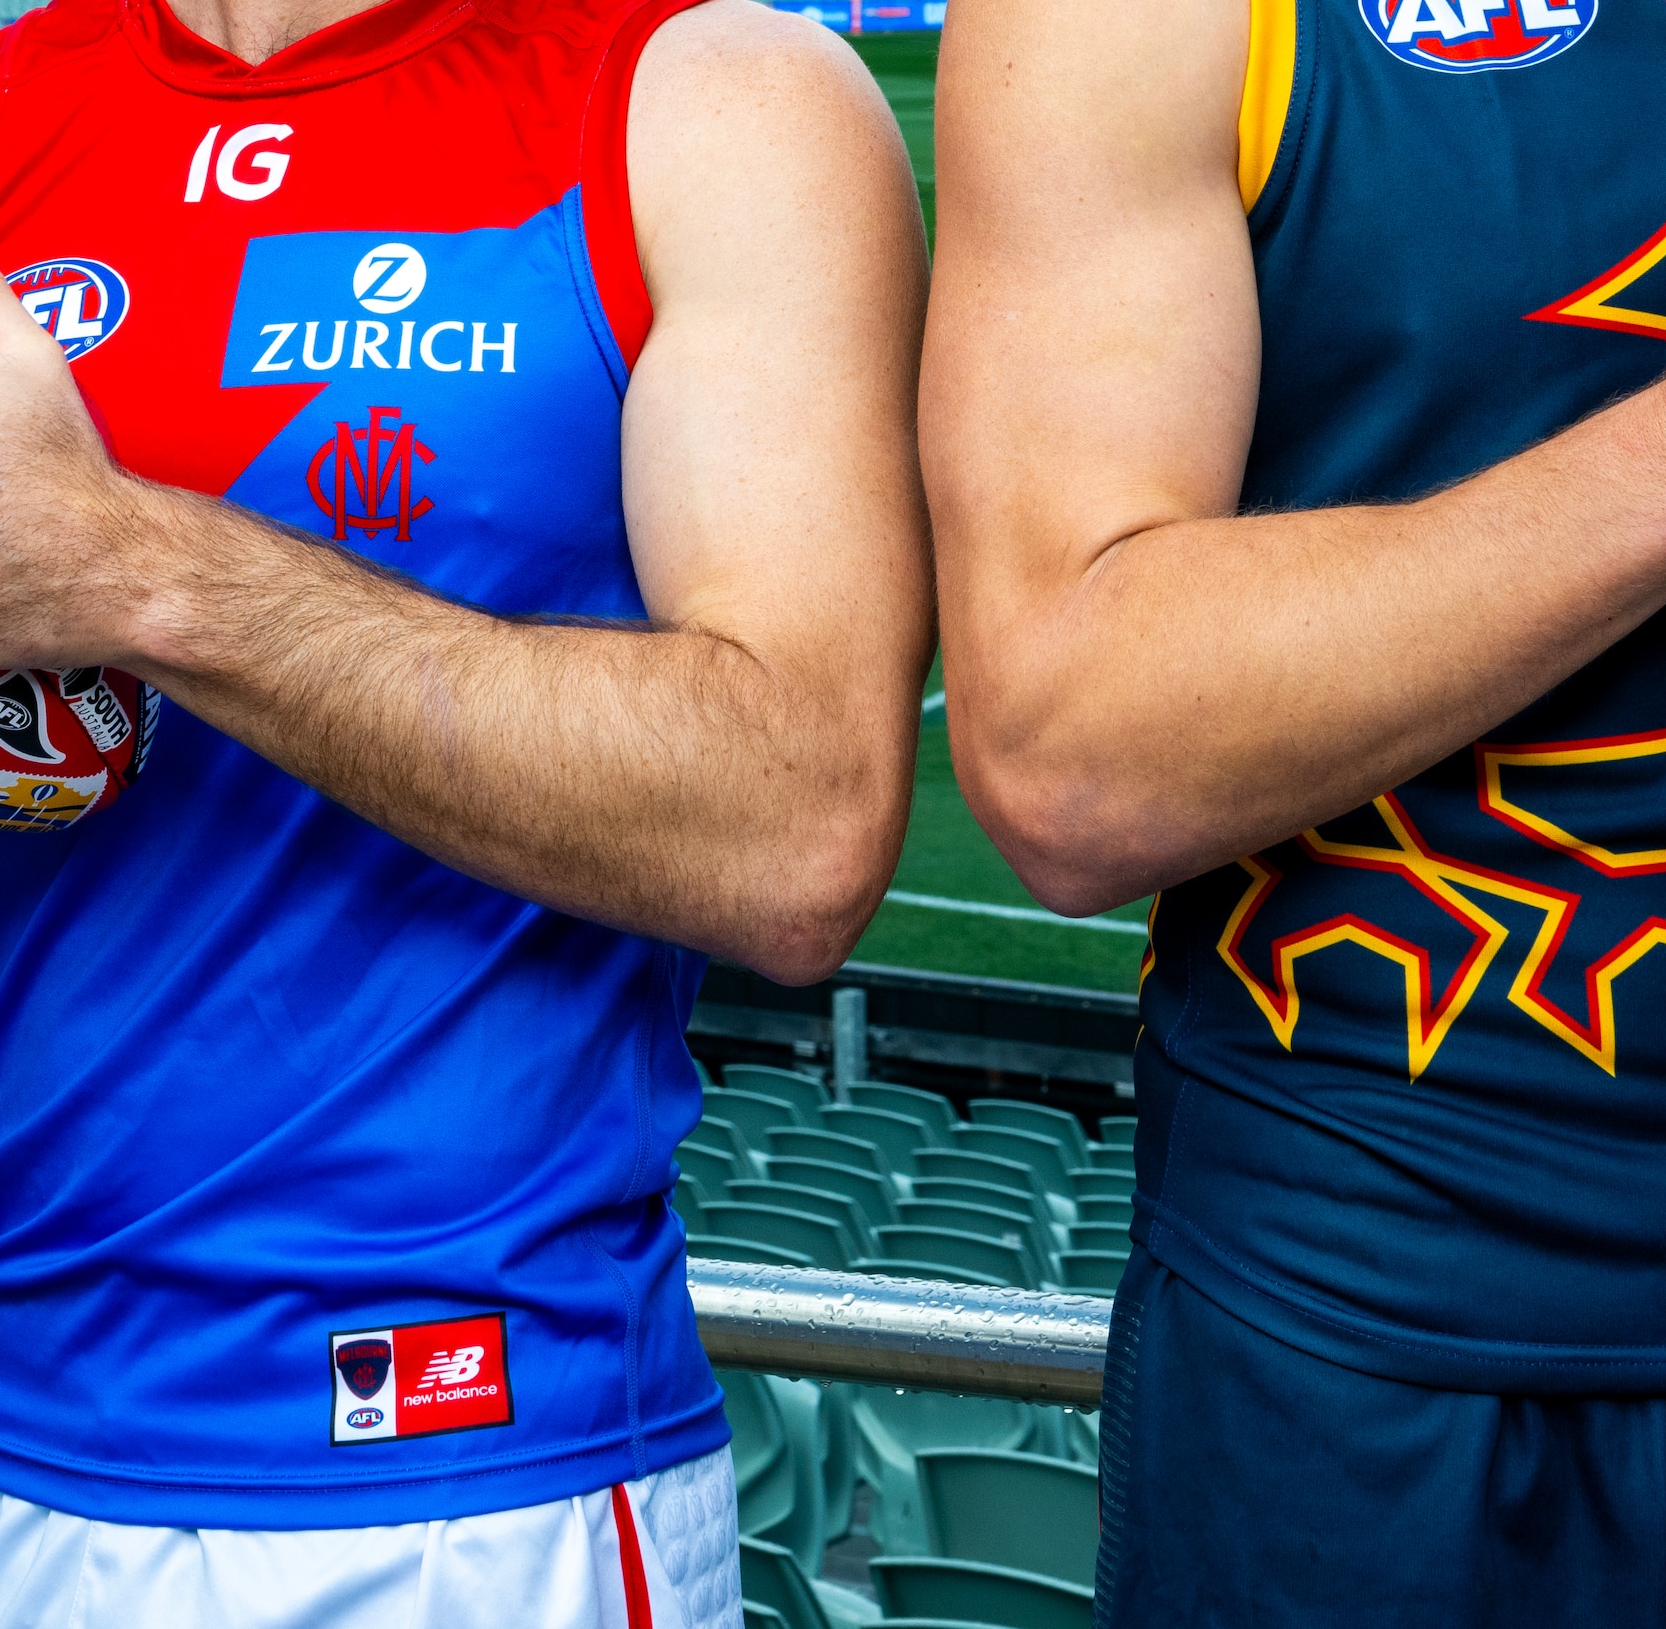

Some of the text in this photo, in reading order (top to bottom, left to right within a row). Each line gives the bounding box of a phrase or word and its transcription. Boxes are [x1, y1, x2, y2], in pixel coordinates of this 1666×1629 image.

[184, 123, 294, 203] IG
[251, 320, 519, 373] ZURICH
[74, 703, 111, 751] AUSTRALIA
[87, 684, 130, 745] SOUTH
[350, 1409, 381, 1425] AFL
[403, 1383, 498, 1408] new balance
